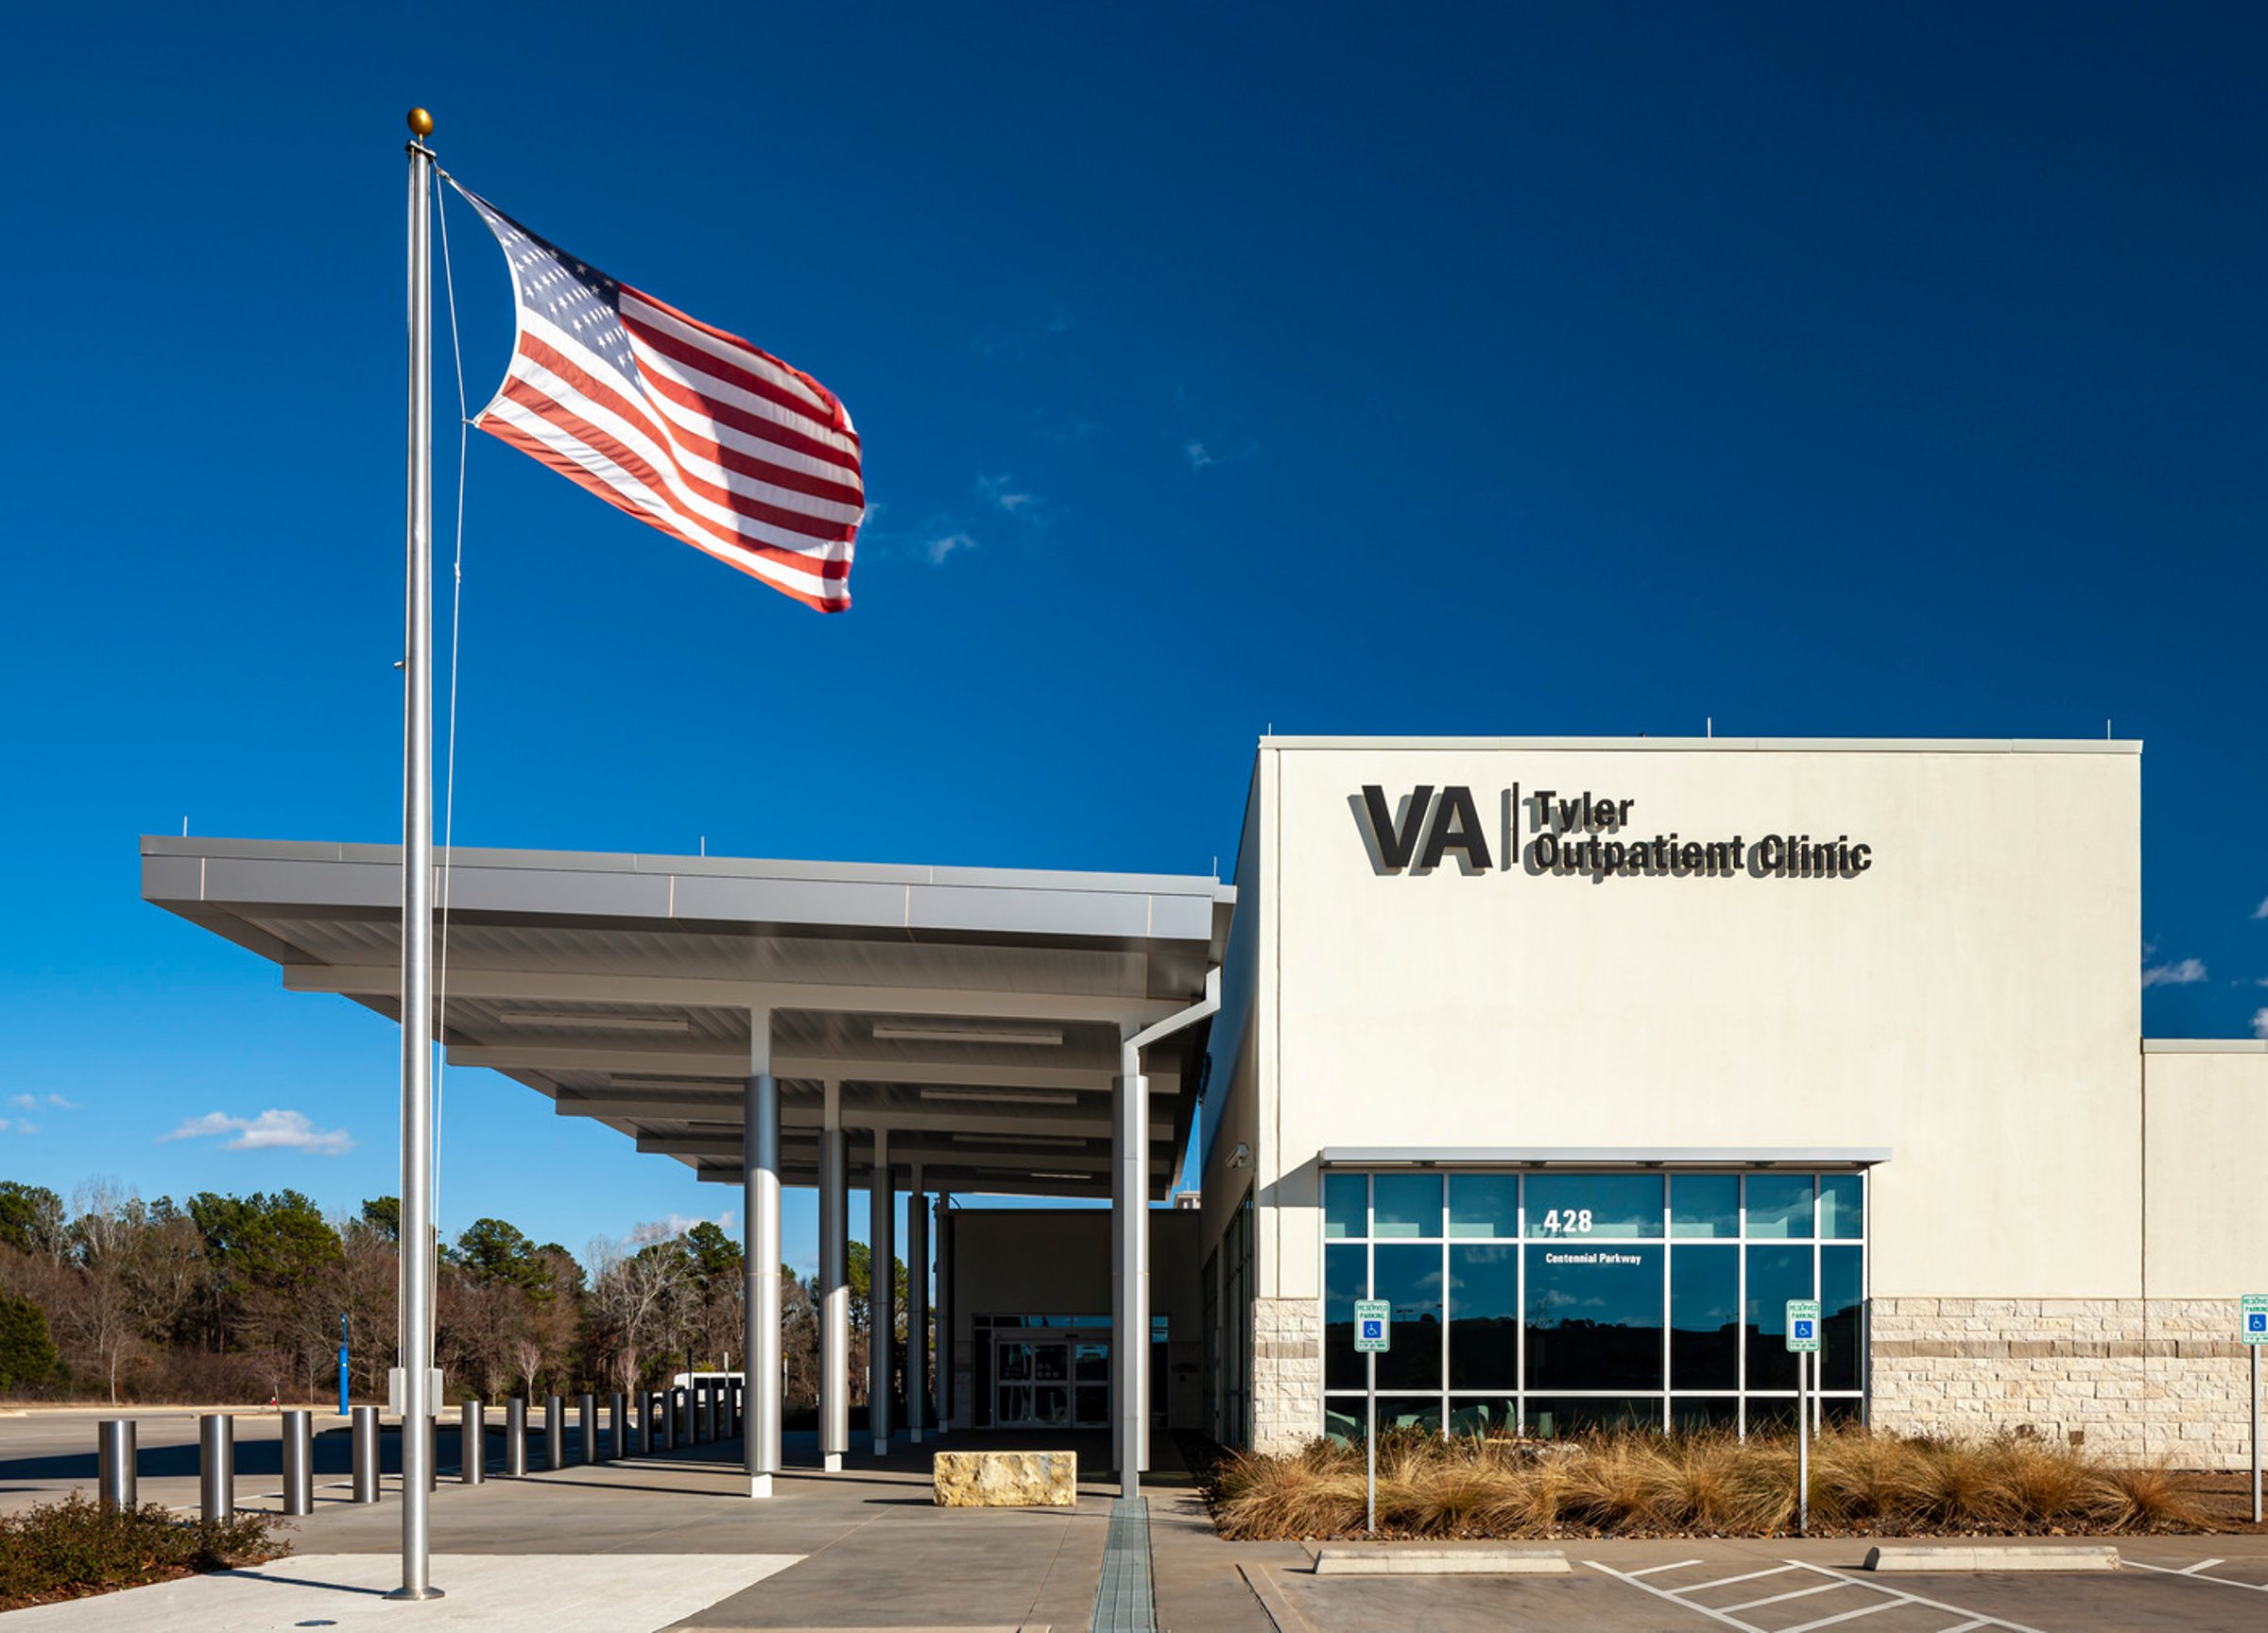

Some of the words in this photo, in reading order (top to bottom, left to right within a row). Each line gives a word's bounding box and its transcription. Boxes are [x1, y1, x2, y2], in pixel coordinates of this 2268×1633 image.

[1362, 785, 1492, 867] VA
[1534, 790, 1634, 832] Tyler
[1535, 834, 1744, 875] Outpatient
[1761, 834, 1871, 870] Clinic
[1544, 1210, 1592, 1232] 428
[1546, 1253, 1597, 1263] Centennial
[1599, 1253, 1641, 1265] Parkway
